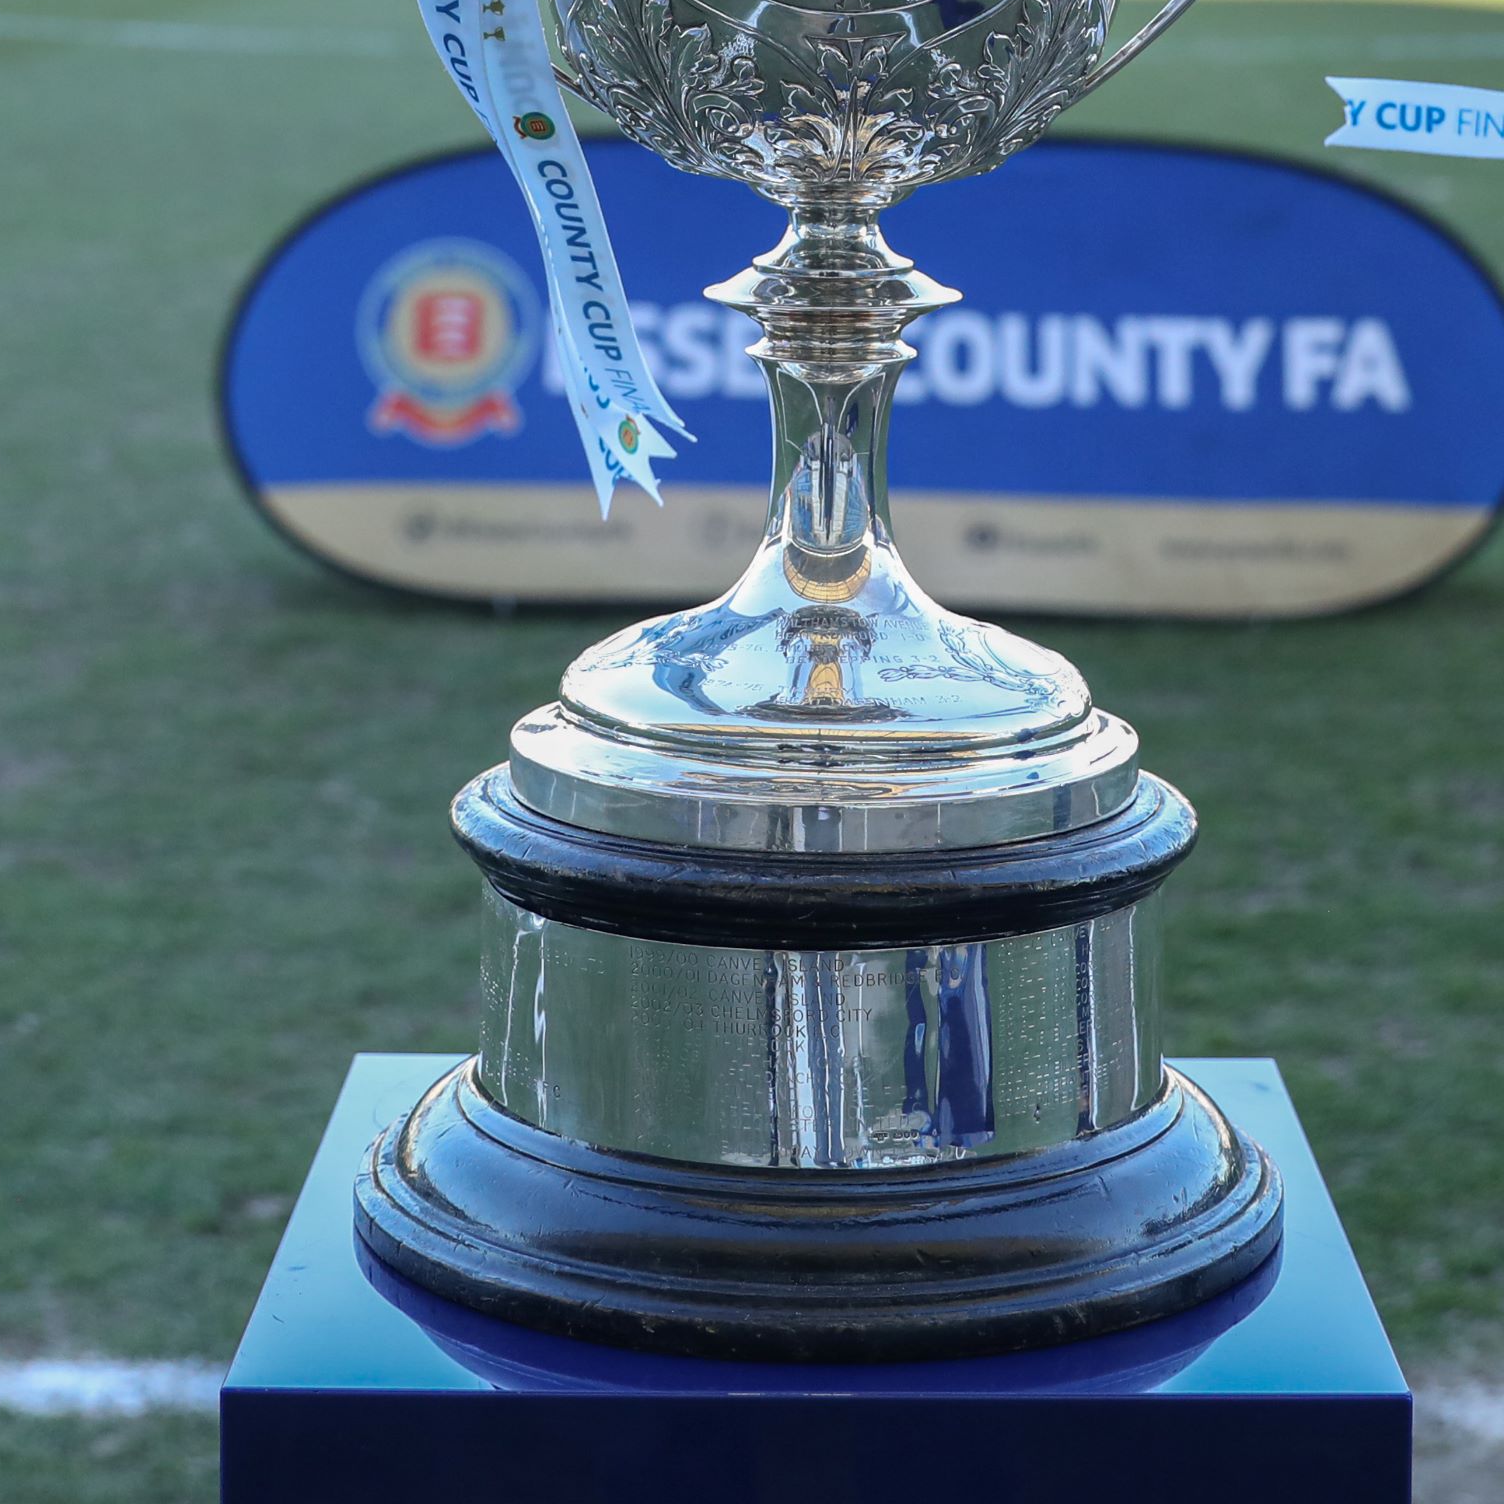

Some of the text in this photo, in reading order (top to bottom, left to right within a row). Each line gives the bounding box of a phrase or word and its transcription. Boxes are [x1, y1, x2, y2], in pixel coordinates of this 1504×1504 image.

[442, 32, 480, 103] CUP
[1375, 101, 1446, 134] CUP
[537, 159, 603, 292] COUNTY
[582, 300, 623, 361] CUP
[1287, 318, 1412, 411] FA
[706, 954, 773, 972] CANVE
[781, 957, 845, 973] ISLAND
[830, 969, 927, 989] REDBRIDGE
[710, 1003, 831, 1023] CHELMSFORD
[835, 1007, 872, 1023] CITY
